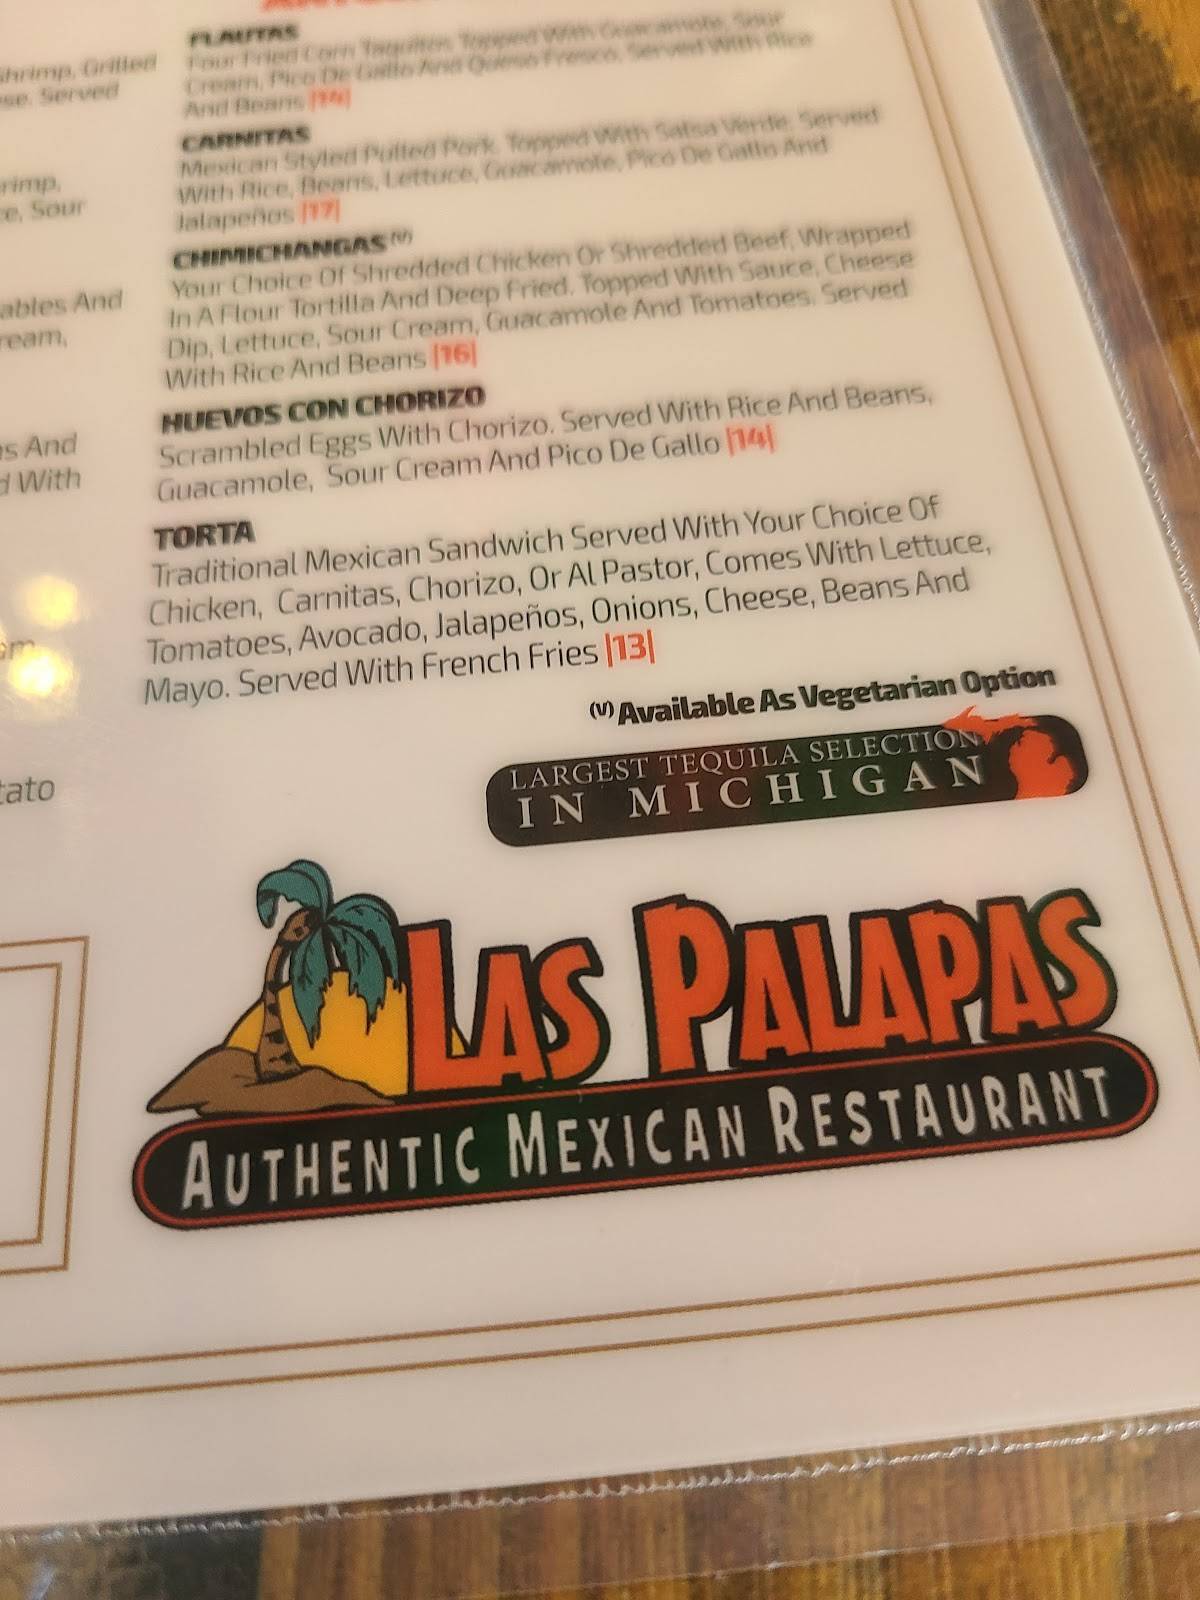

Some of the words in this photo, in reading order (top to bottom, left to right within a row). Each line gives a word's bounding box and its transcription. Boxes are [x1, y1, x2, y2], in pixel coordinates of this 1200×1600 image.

[189, 24, 299, 48] FLAUTAS
[40, 81, 120, 105] Served
[184, 96, 229, 118] And
[235, 94, 304, 113] Beans
[178, 179, 234, 205] With
[626, 144, 675, 169] Pico
[681, 141, 712, 164] De
[718, 136, 778, 161] Gallo
[783, 133, 829, 156] And
[180, 154, 277, 179] Mexican
[284, 142, 357, 171] Styled
[593, 122, 649, 144] With
[181, 125, 311, 153] CARNITAS
[31, 198, 86, 220] Sour
[169, 307, 191, 329] In
[200, 306, 214, 326] A
[221, 301, 280, 324] Flour
[291, 292, 374, 320] Tortilla
[380, 288, 428, 313] And
[437, 285, 499, 309] Deep
[581, 267, 668, 298] Topped
[674, 262, 734, 287] With
[824, 249, 914, 275] Cheese
[171, 277, 225, 301] Your
[233, 269, 312, 294] Choice
[320, 266, 344, 288] Of
[352, 259, 469, 285] Shredded
[476, 248, 570, 270] Chicken
[578, 244, 601, 266] Or
[610, 234, 727, 264] Shredded
[798, 220, 911, 249] Wrapped
[73, 290, 123, 314] And
[222, 327, 321, 355] Lettuce,
[328, 321, 383, 346] Sour
[392, 315, 481, 341] Cream,
[487, 300, 627, 329] Guacamole
[633, 296, 682, 321] And
[820, 279, 908, 306] Served
[165, 365, 225, 391] With
[234, 359, 284, 385] Rice
[290, 354, 341, 379] And
[349, 348, 427, 375] Beans
[160, 403, 283, 435] HUEVOS
[288, 397, 350, 423] CON
[355, 384, 486, 417] CHORIZO
[160, 434, 301, 469] Scrambled
[309, 430, 372, 459] Eggs
[378, 420, 440, 449] With
[561, 403, 652, 433] Served
[658, 398, 721, 424] With
[728, 391, 783, 420] Rice
[787, 388, 839, 414] And
[25, 432, 77, 458] And
[157, 468, 314, 504] Guacamole,
[327, 461, 385, 489] Sour
[396, 450, 482, 481] Cream
[488, 446, 541, 472] And
[547, 442, 602, 468] Pico
[610, 437, 645, 462] De
[652, 431, 720, 459] Gallo
[18, 467, 82, 496] With
[152, 552, 299, 588] Traditional
[306, 542, 421, 575] Mexican
[429, 526, 564, 564] Sandwich
[572, 518, 667, 552] Served
[673, 512, 739, 541] With
[744, 507, 805, 536] Your
[811, 502, 901, 530] Choice
[908, 494, 941, 521] Of
[154, 520, 256, 551] TORTA
[149, 596, 263, 627] Chicken,
[278, 584, 401, 616] Carnitas,
[408, 572, 523, 603] Chorizo,
[529, 563, 562, 591] Or
[568, 560, 596, 588] Al
[603, 554, 700, 584] Pastor,
[705, 548, 802, 576] Comes
[805, 535, 874, 568] With
[880, 529, 991, 561] Lettuce,
[147, 631, 293, 666] Tomatoes,
[299, 617, 427, 650] Avocado,
[434, 602, 584, 640] Jalapeños,
[592, 592, 698, 624] Onions,
[705, 585, 816, 615] Cheese,
[822, 573, 910, 604] Beans
[914, 566, 970, 595] And
[239, 662, 338, 698] Served
[345, 655, 414, 687] With
[422, 646, 521, 681] French
[530, 637, 599, 671] Fries
[617, 690, 755, 726] Available
[760, 688, 797, 713] As
[798, 674, 958, 711] Vegetarian
[960, 666, 1056, 696] Option
[511, 756, 649, 791] LARGEST
[659, 743, 800, 779] TEQUILA
[808, 728, 982, 763] SELECTION
[517, 792, 585, 829] IN
[628, 755, 984, 819] MICHIGAN
[632, 888, 1117, 1078] PALAPAS
[180, 1135, 481, 1213] AUTHENTIC
[506, 1100, 746, 1179] MEXICAN
[769, 1064, 1112, 1155] RESTAURANT
